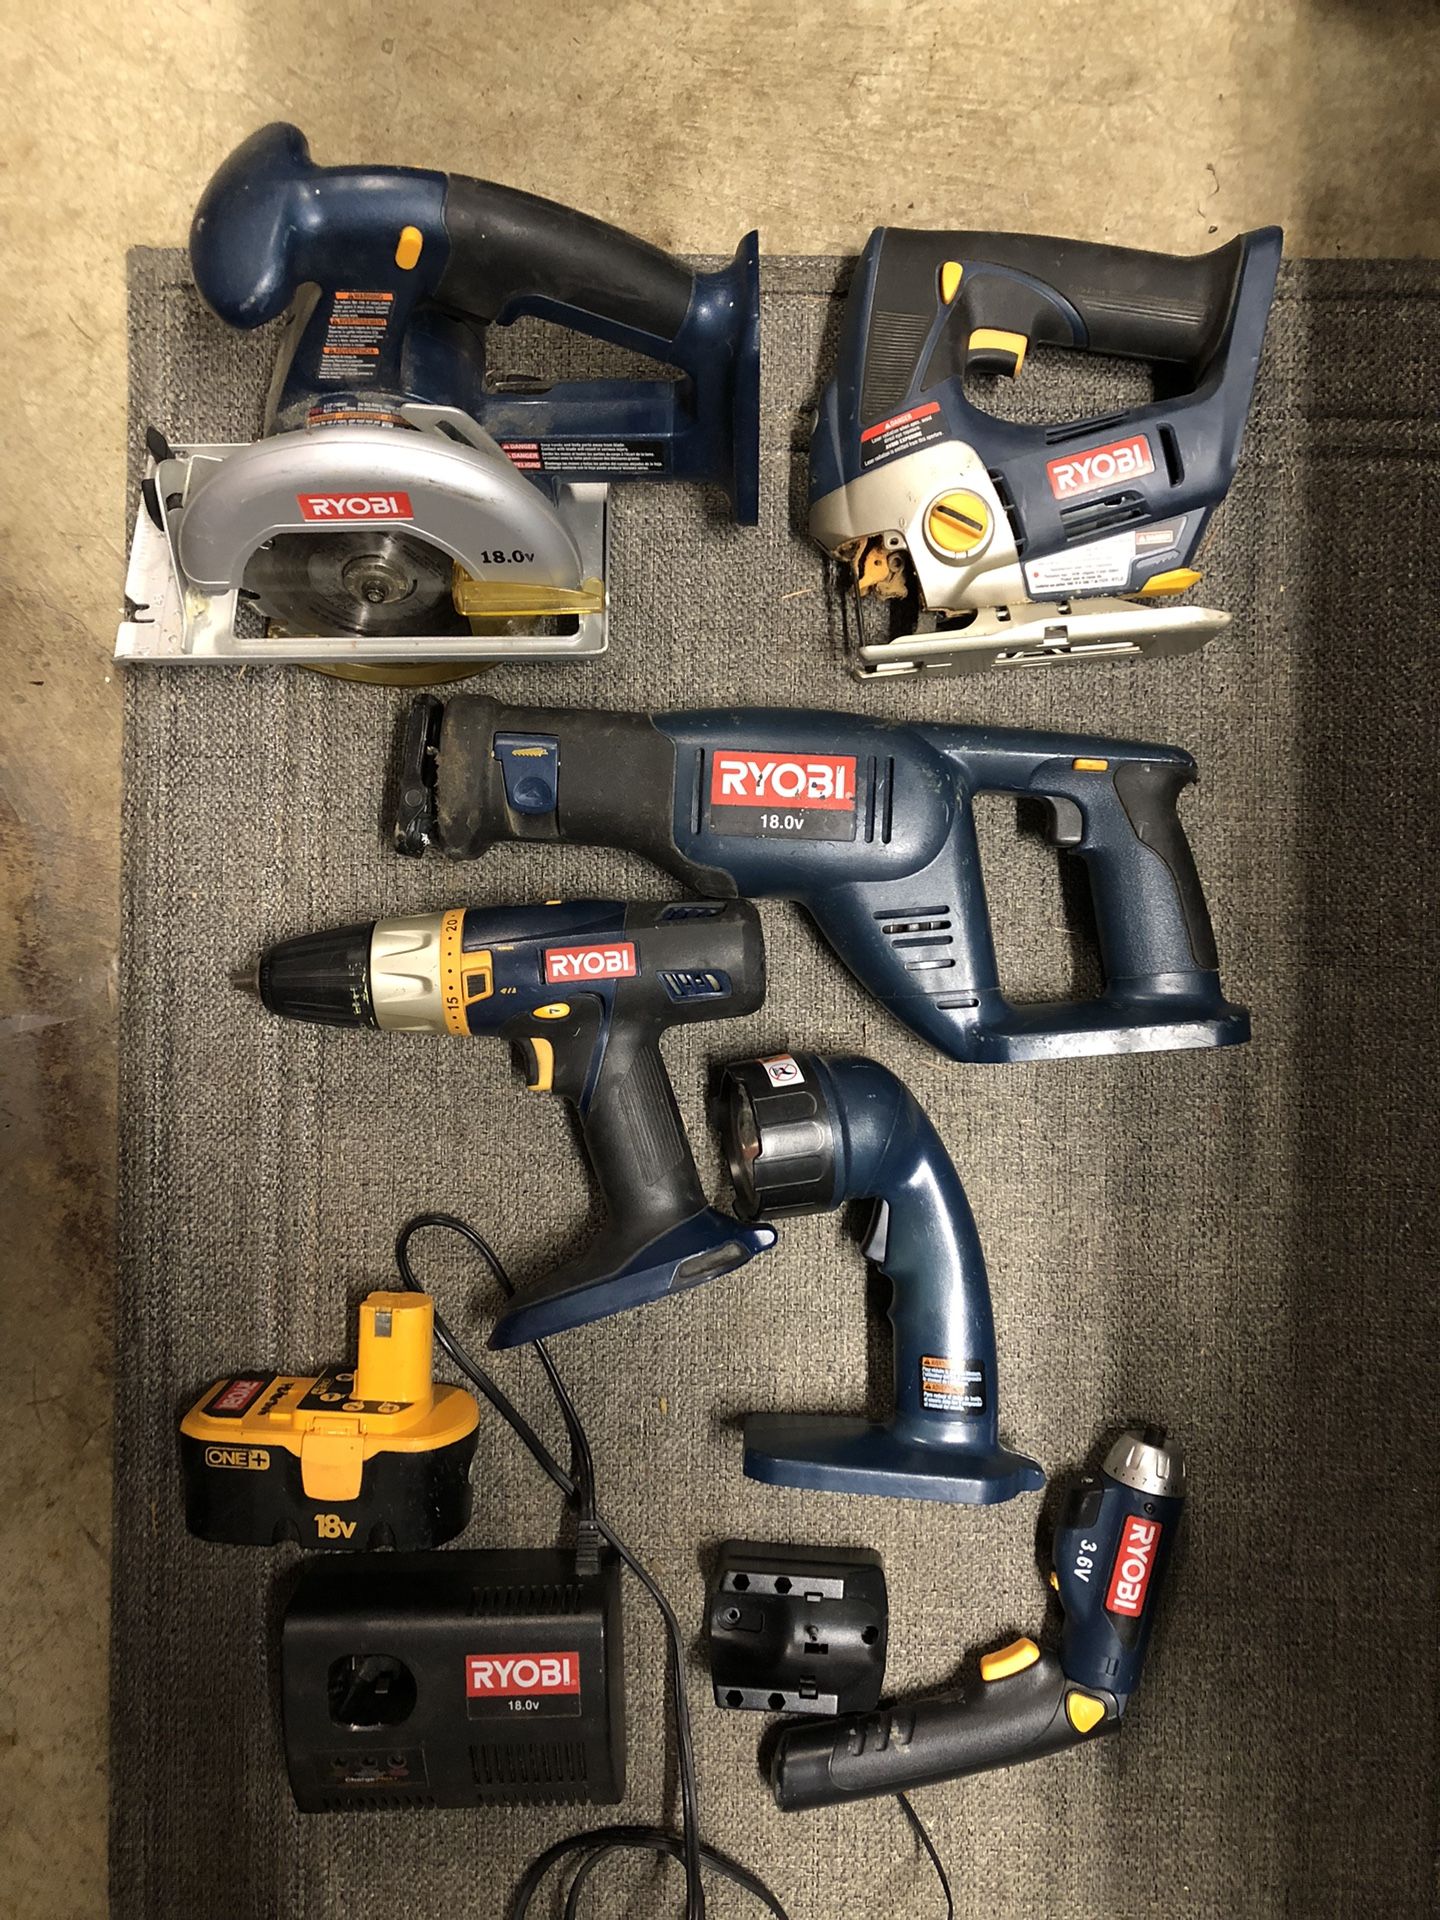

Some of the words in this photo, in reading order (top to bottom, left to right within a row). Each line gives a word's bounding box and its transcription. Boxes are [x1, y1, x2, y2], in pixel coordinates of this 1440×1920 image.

[1052, 444, 1144, 491] RYOBI
[308, 496, 399, 515] RYOBI
[481, 549, 534, 564] 18.0v
[720, 760, 845, 800] RYOBI
[760, 814, 804, 829] 18.0v
[446, 919, 458, 932] 20
[549, 949, 630, 977] RYOBI
[446, 996, 459, 1011] 15
[219, 1381, 260, 1408] RYOBI
[1074, 1539, 1098, 1583] 3.6V
[1113, 1523, 1156, 1610] RYOBI
[471, 1658, 570, 1689] RYOBI
[508, 1700, 540, 1711] 18.0v
